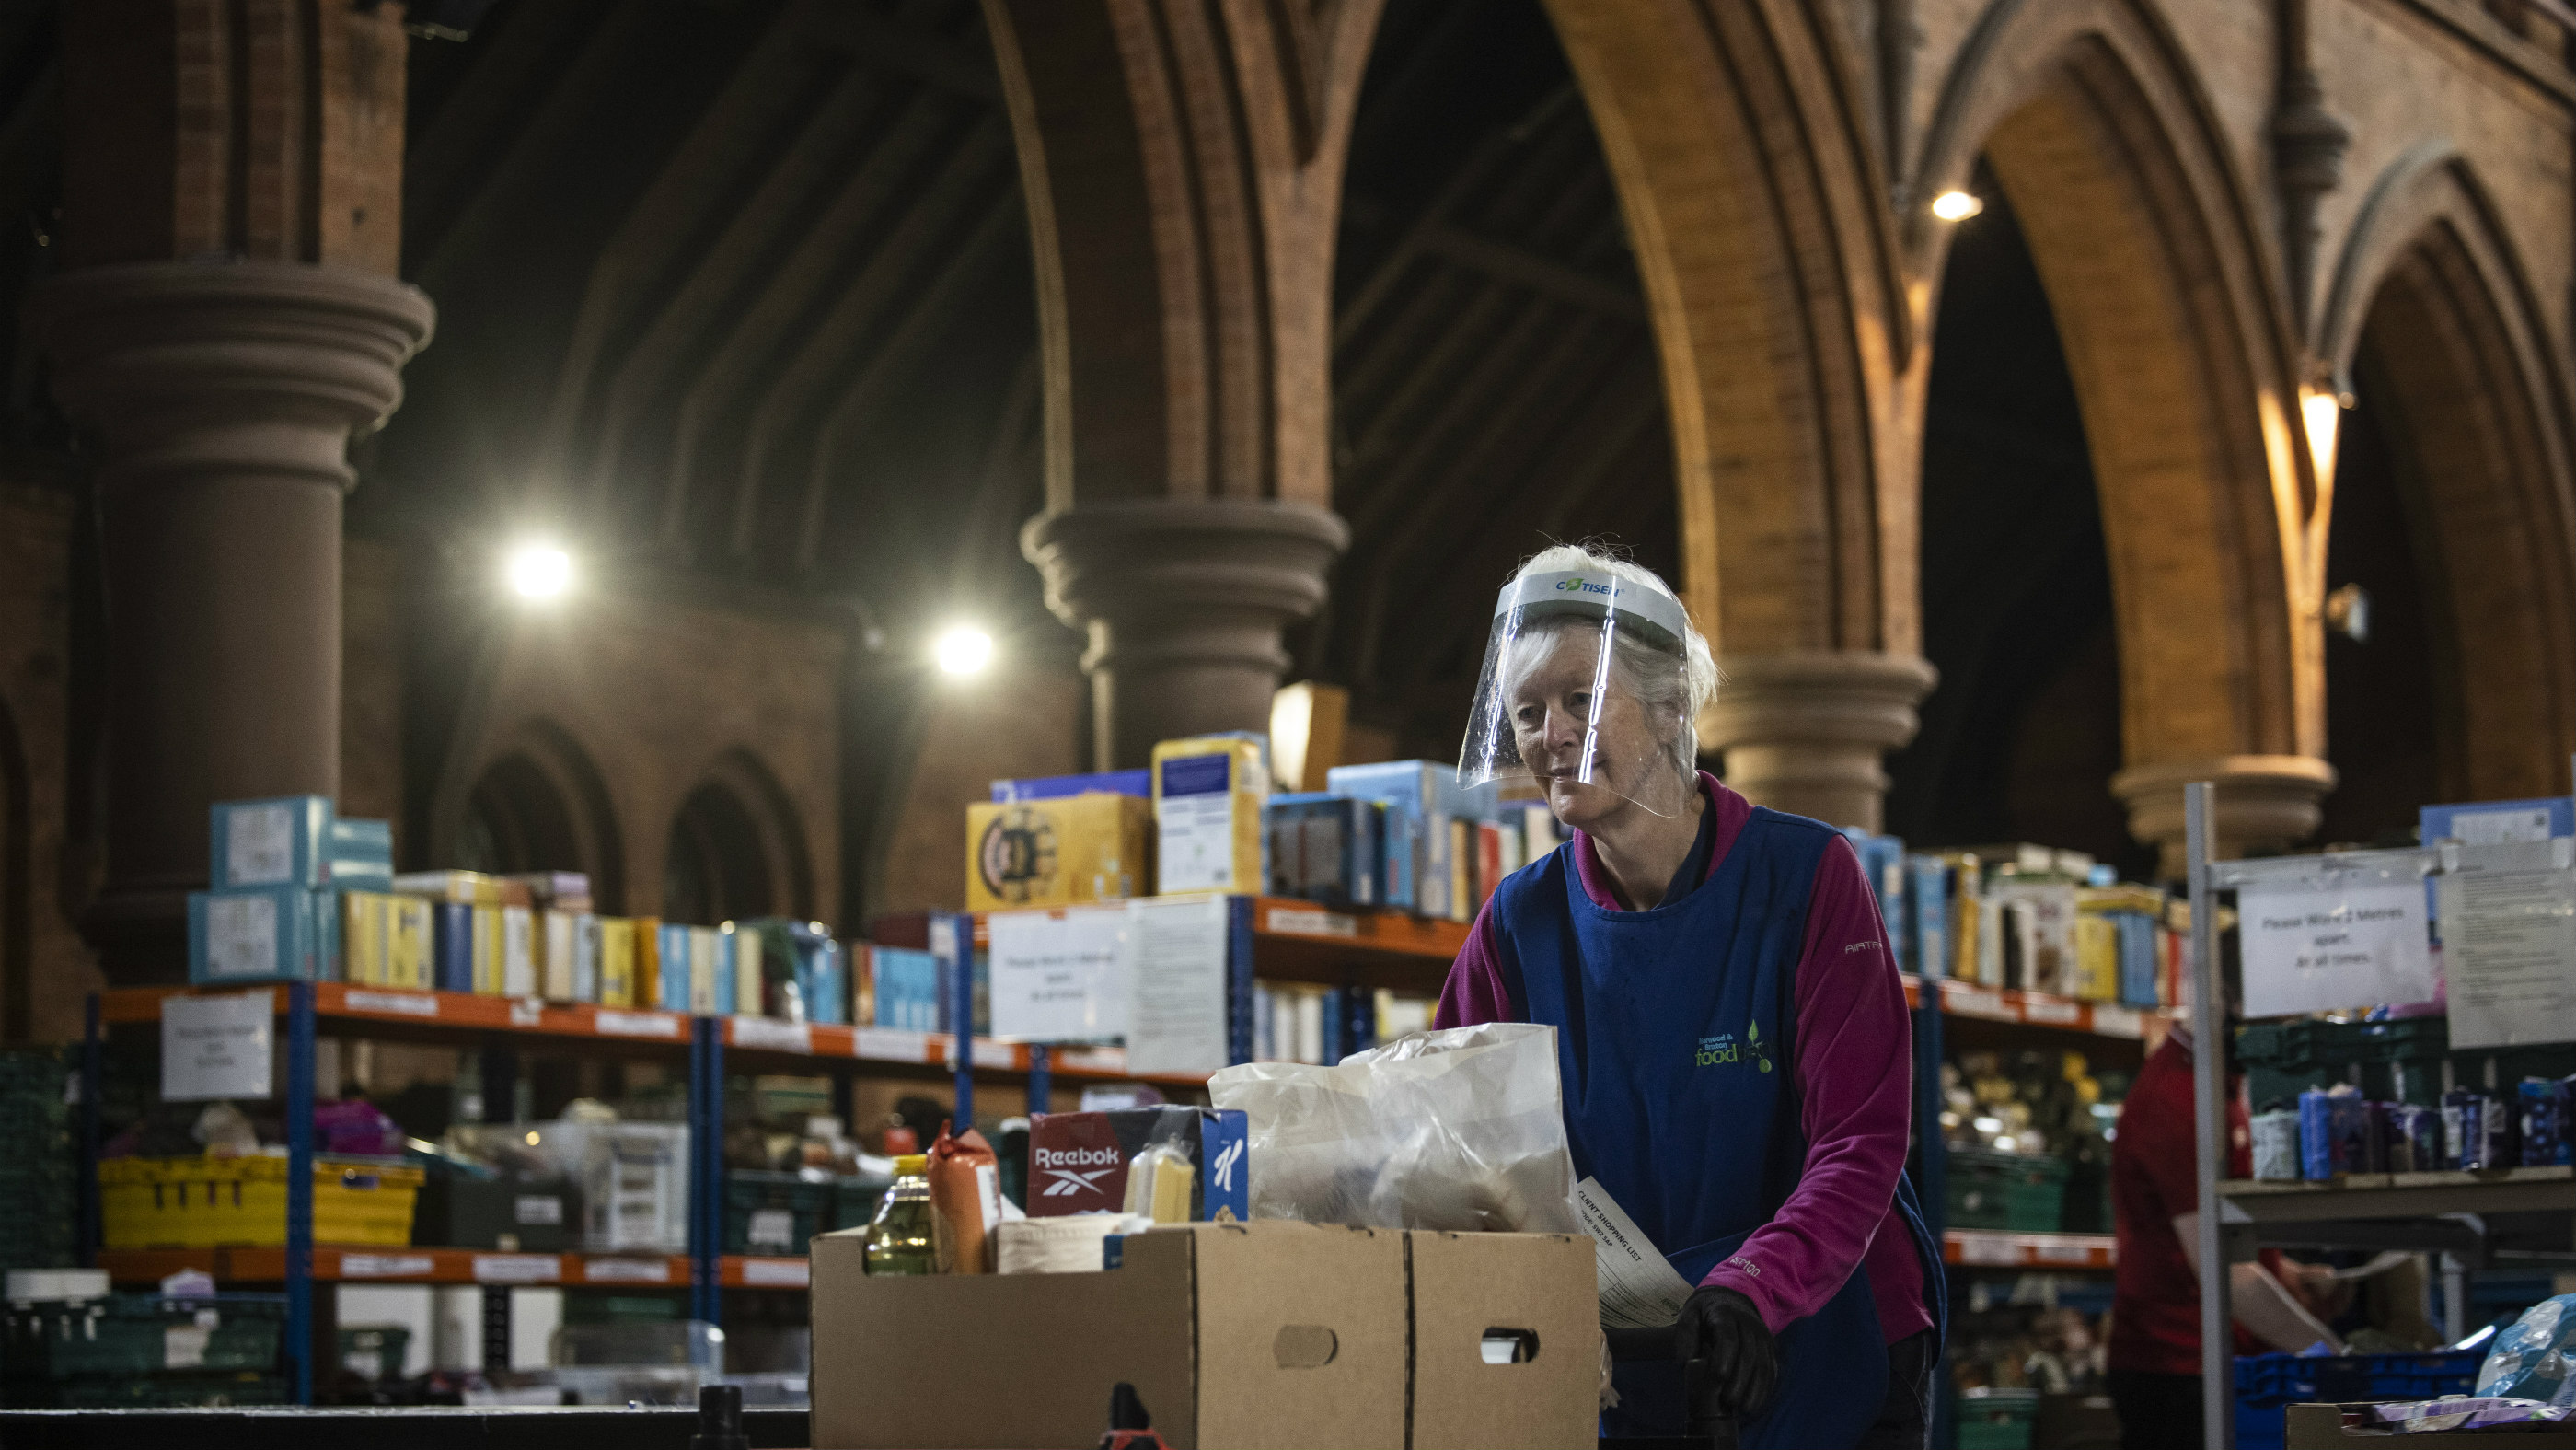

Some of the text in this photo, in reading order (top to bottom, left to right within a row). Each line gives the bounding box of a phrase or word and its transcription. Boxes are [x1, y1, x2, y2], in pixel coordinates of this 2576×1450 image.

[1035, 1147, 1120, 1168] Reebok
[1578, 1190, 1600, 1214] CLIENT
[1598, 1212, 1629, 1248] SHOPPING
[1627, 1246, 1643, 1262] LIST
[1592, 1223, 1604, 1237] SW2
[1730, 1256, 1761, 1277] AT100
